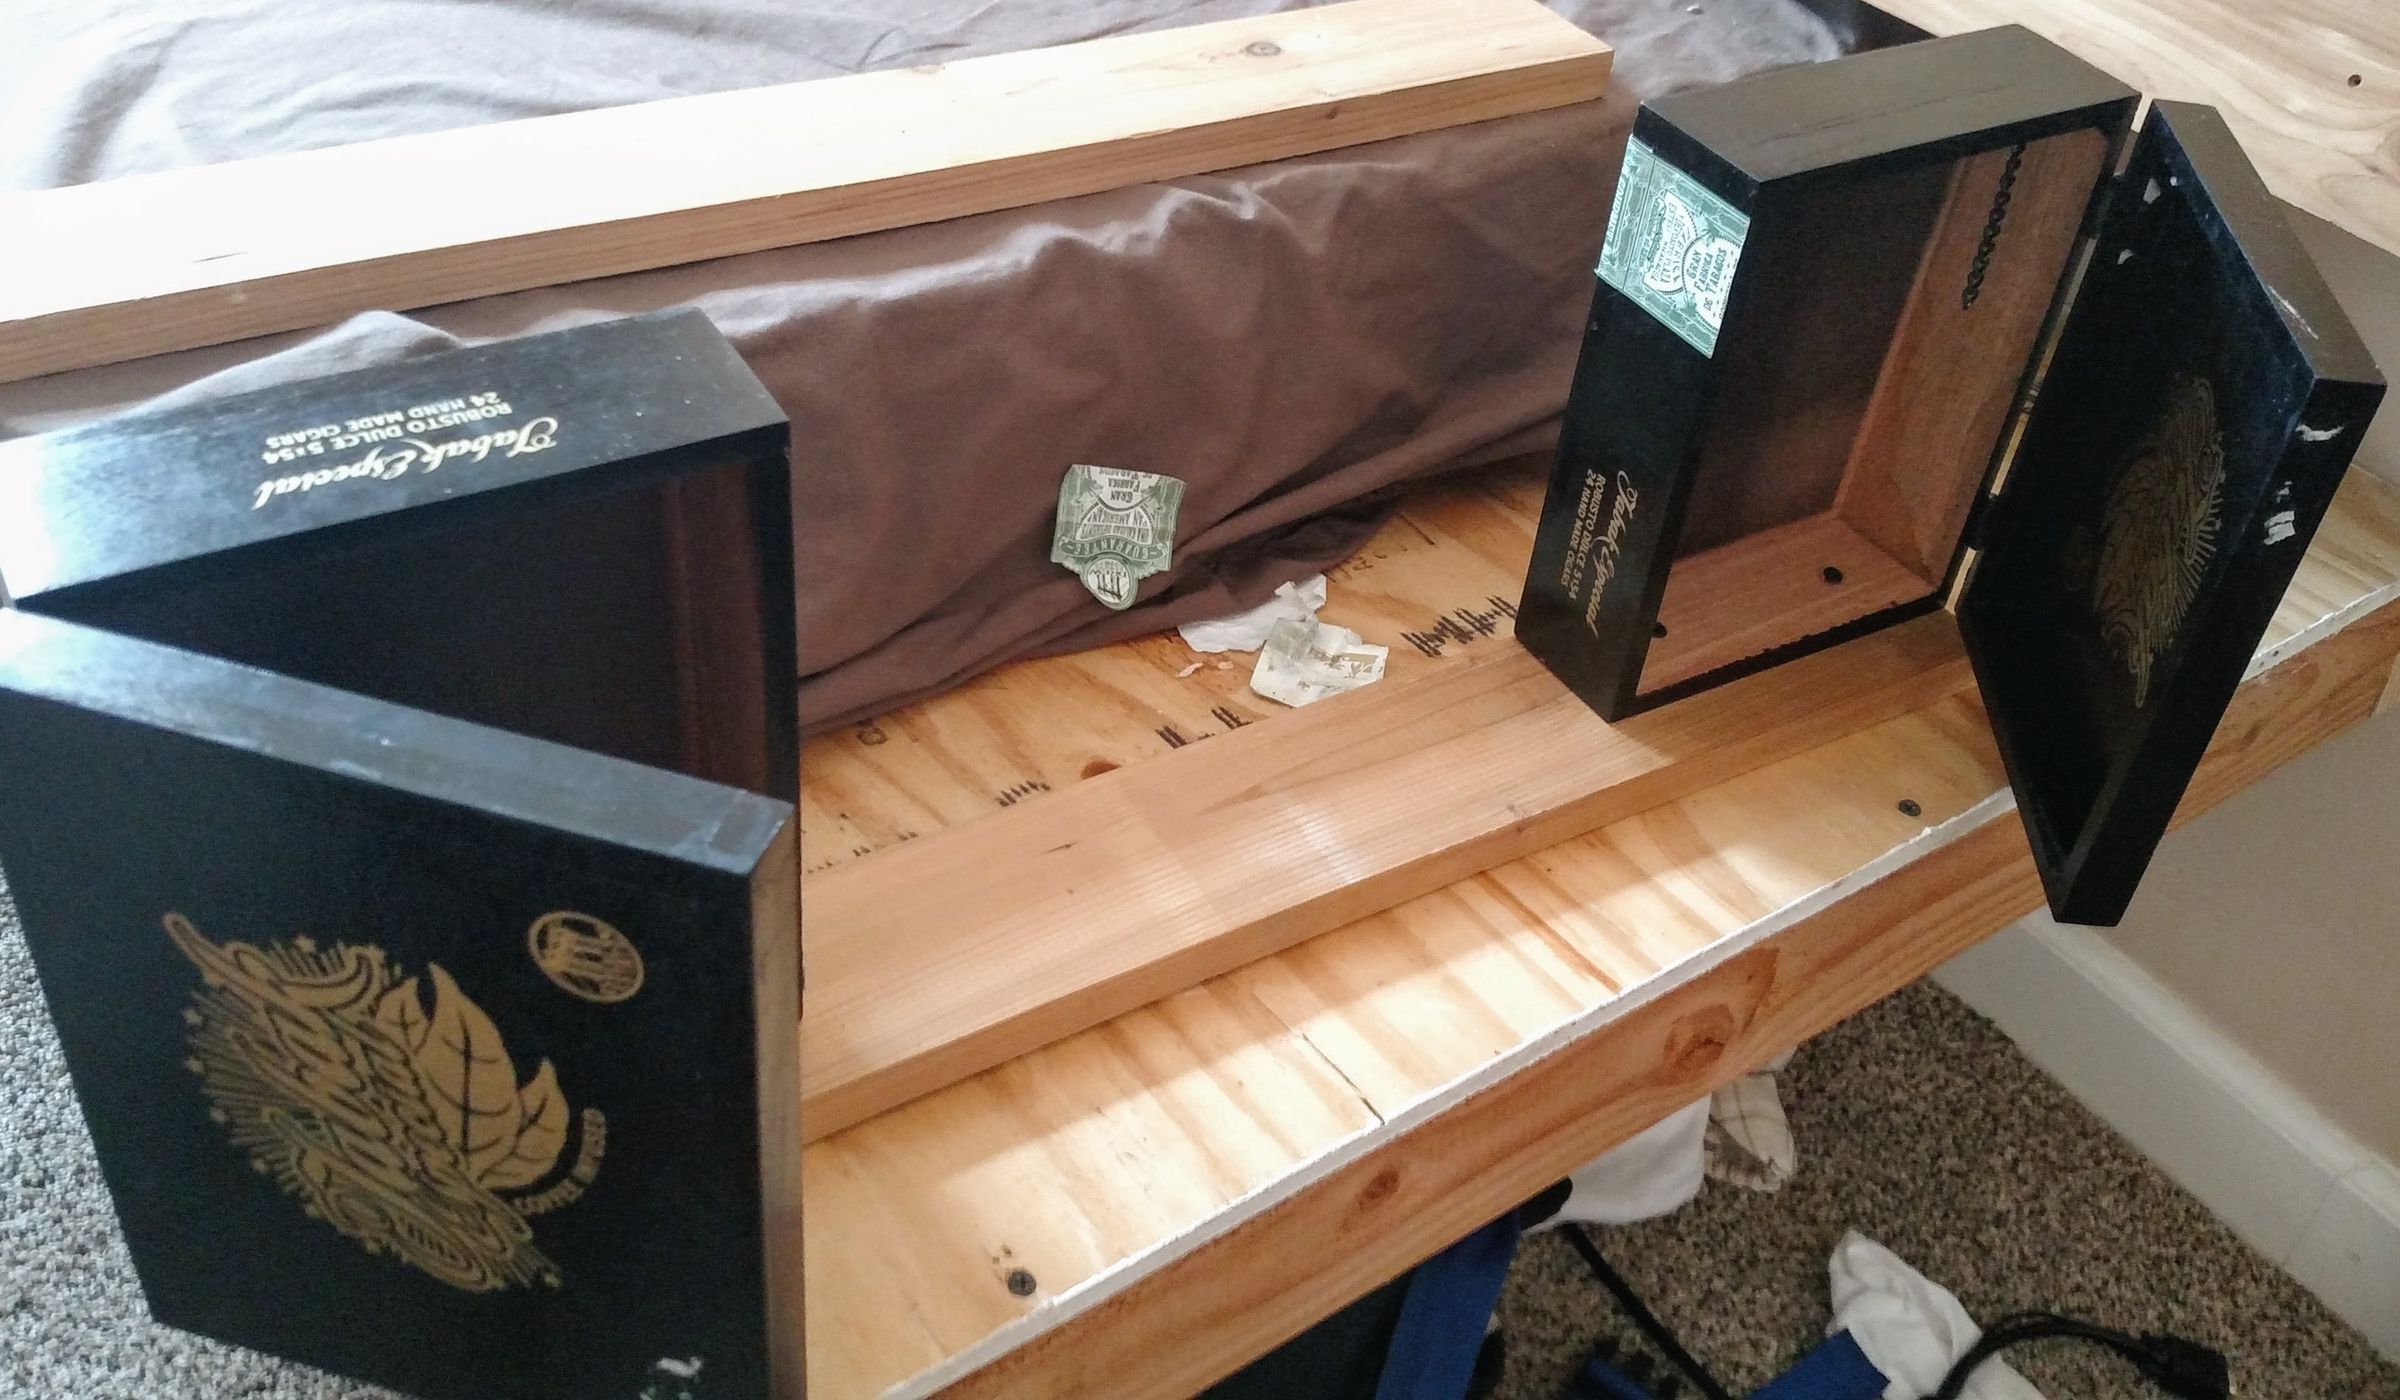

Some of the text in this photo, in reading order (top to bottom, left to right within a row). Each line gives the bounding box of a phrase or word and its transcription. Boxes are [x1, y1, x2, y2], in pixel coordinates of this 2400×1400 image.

[1685, 249, 1701, 279] GRAN
[1693, 251, 1713, 293] FABRICA
[1702, 246, 1726, 311] DE TABACOS
[265, 391, 499, 448] 24 HAND MADE CIGARS
[329, 422, 401, 451] DULCE
[406, 401, 513, 434] ROBUSTO
[250, 416, 560, 511] Tabak Especial
[1110, 490, 1134, 503] GRAN
[1586, 473, 1607, 531] ROBUSTO
[1073, 537, 1150, 560] GUARANTEE
[1560, 469, 1597, 587] 24 HAND MADE CIGARS
[1574, 531, 1593, 572] DULCE
[1586, 470, 1639, 639] Tabak Especial
